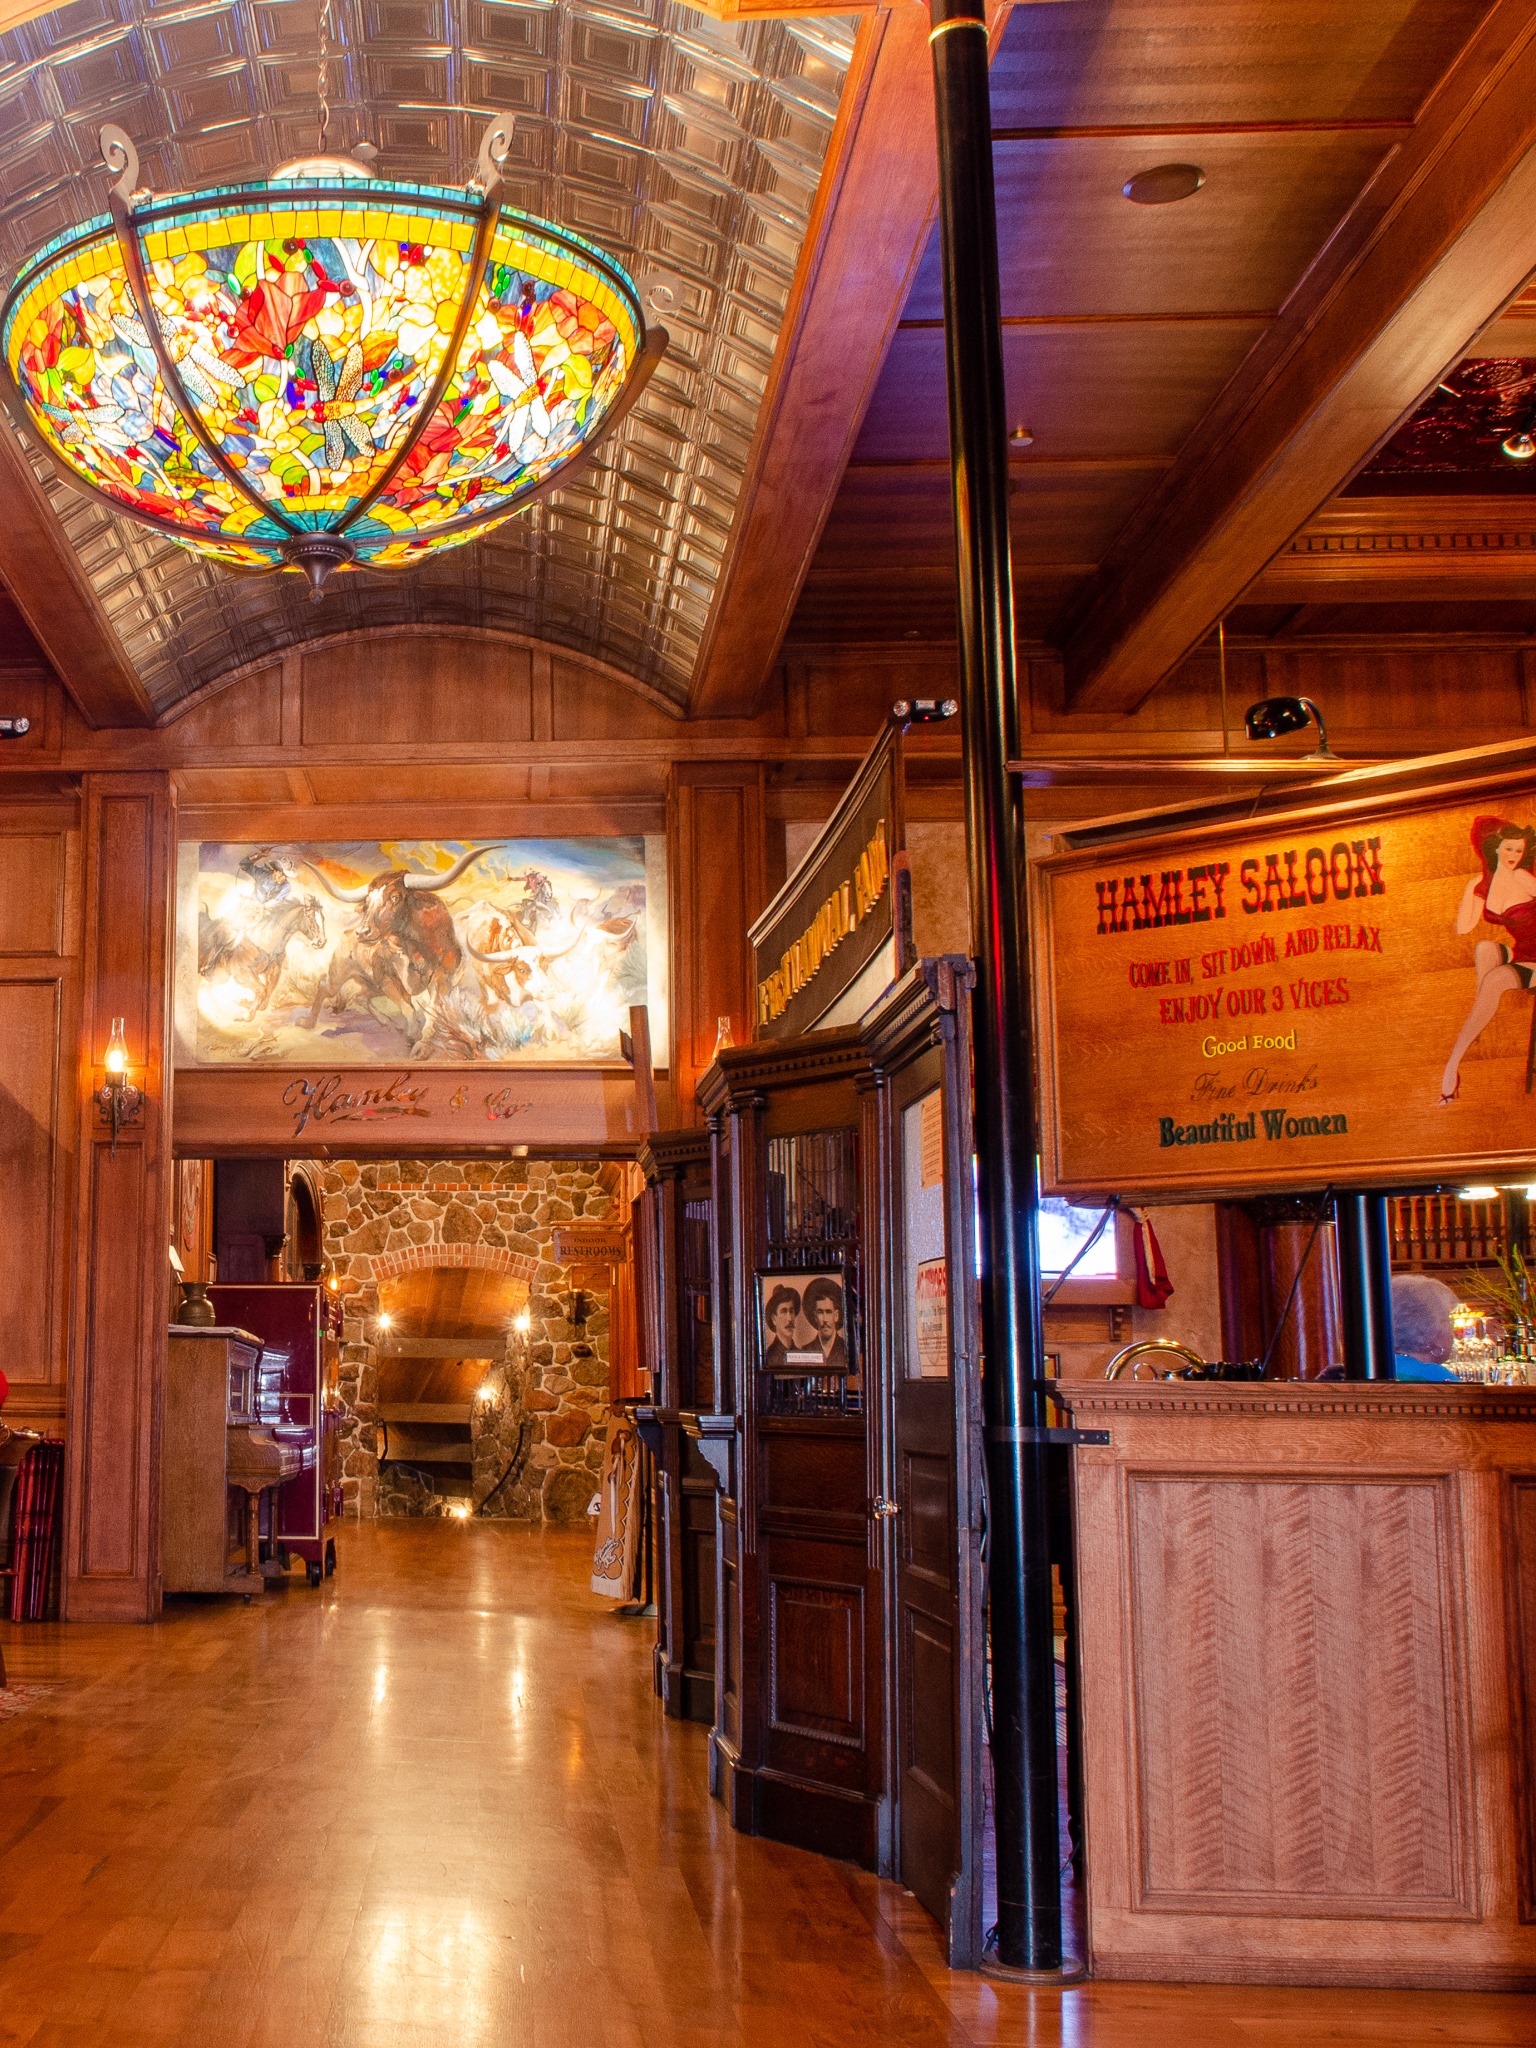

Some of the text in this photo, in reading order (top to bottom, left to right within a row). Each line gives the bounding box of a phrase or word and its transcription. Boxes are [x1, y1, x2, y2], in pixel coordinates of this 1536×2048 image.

[1095, 836, 1386, 935] HAMLEY SALOON
[1128, 961, 1172, 989] COME
[1201, 950, 1228, 979] SIT
[1284, 927, 1320, 958] AND
[1322, 924, 1383, 954] RELAX
[1159, 977, 1351, 1025] ENJOY OUR 3 VICES
[1202, 1029, 1297, 1058] Good Food
[1190, 1063, 1319, 1101] Fine Drinks
[1159, 1108, 1348, 1148] Beautiful Women
[560, 1246, 621, 1256] RESTROOMS
